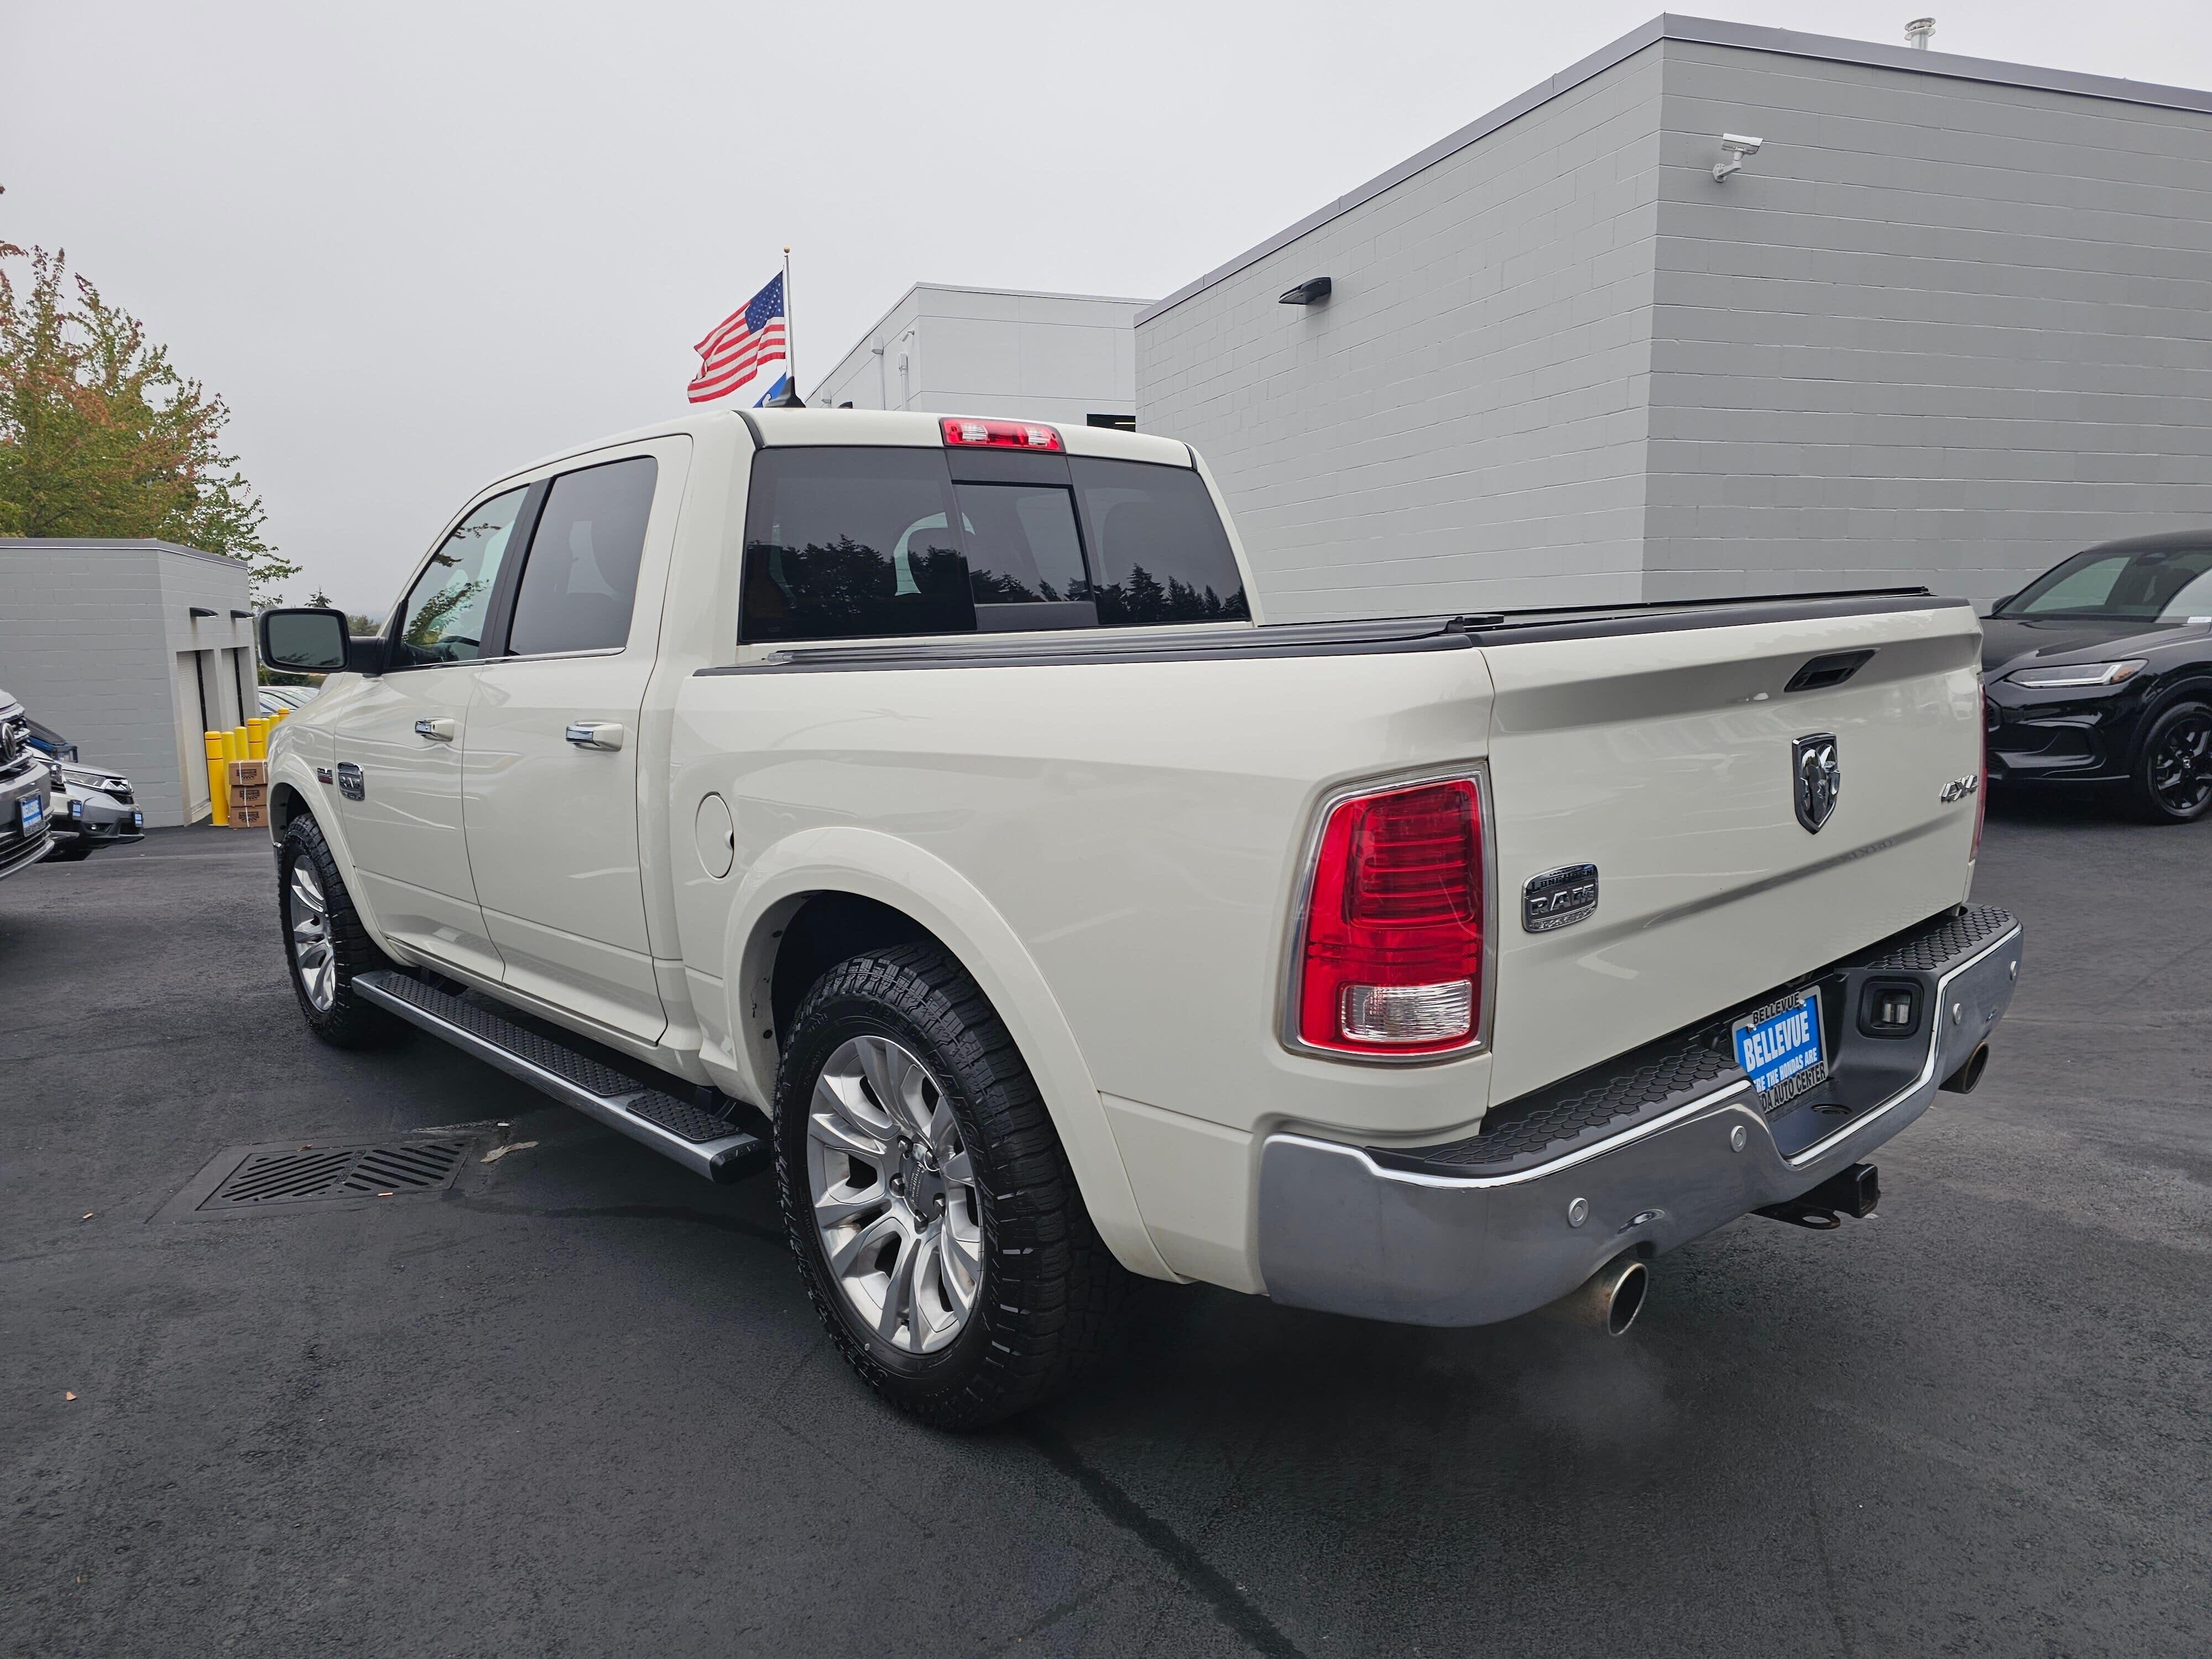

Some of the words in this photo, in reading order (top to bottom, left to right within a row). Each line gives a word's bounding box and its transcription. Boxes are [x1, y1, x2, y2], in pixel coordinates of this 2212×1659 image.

[1530, 884, 1594, 915] RAM
[1752, 993, 1799, 1024] BELLEVUE
[1743, 1011, 1809, 1072] BELLEVUE
[1766, 1068, 1779, 1087] THE
[1779, 1054, 1804, 1081] HONDAS
[1804, 1047, 1818, 1066] ARE
[1773, 1078, 1794, 1107] AUTO
[1796, 1061, 1825, 1093] CENTER
